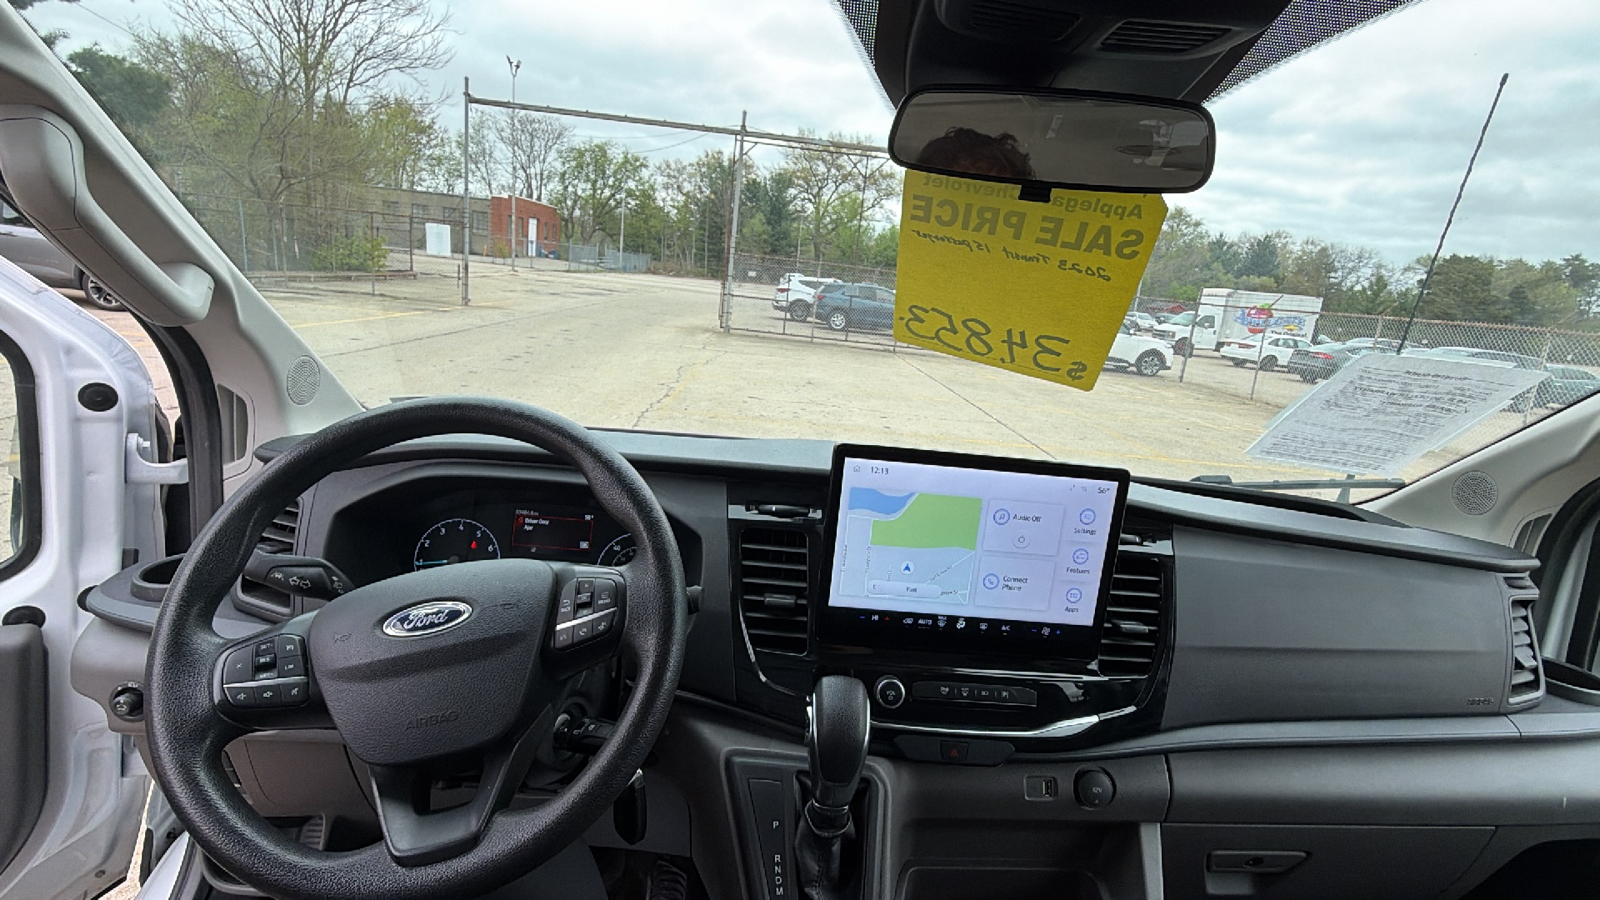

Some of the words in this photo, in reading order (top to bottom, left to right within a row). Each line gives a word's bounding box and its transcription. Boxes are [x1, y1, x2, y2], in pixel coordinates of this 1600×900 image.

[871, 466, 889, 475] 12:13
[1013, 513, 1031, 522] Audio
[1032, 514, 1042, 522] Off
[440, 527, 446, 535] 3
[476, 530, 482, 538] 5
[1074, 527, 1097, 536] Settings
[487, 544, 494, 552] 6
[1066, 566, 1090, 575] Features
[1003, 575, 1028, 584] Connect
[1002, 583, 1022, 592] Phone
[1065, 606, 1079, 614] Apps
[403, 609, 450, 630] Ford
[918, 618, 932, 626] AUTO
[405, 711, 459, 731] AIRBAG
[772, 820, 779, 829] P
[774, 854, 781, 863] R
[774, 865, 781, 874] N
[775, 876, 782, 885] D
[775, 887, 783, 895] M
